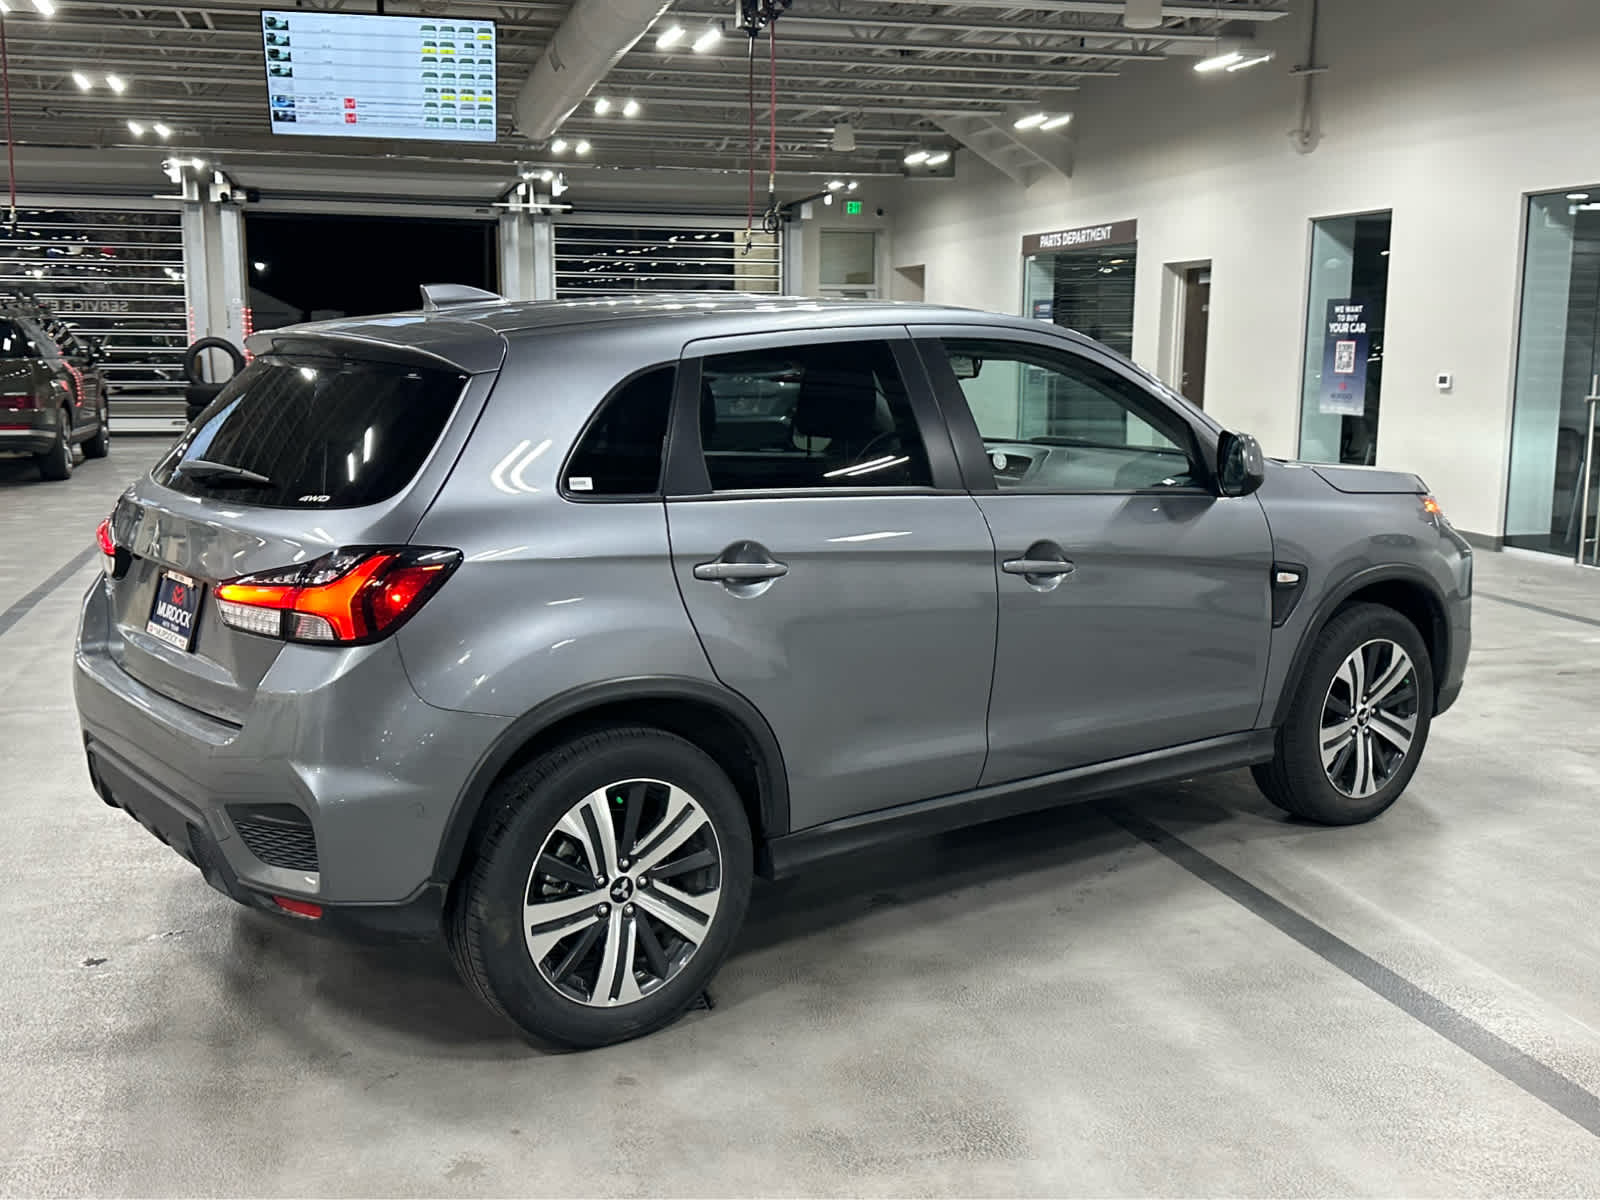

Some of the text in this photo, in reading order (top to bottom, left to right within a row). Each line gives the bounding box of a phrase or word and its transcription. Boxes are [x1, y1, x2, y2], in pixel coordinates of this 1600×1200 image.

[1040, 226, 1112, 248] PARTS DEPARTMENT
[1334, 305, 1364, 313] WE WANT
[1337, 314, 1359, 322] TO BUY
[1329, 322, 1366, 333] YOUR CAR
[157, 600, 192, 629] MURDOCK
